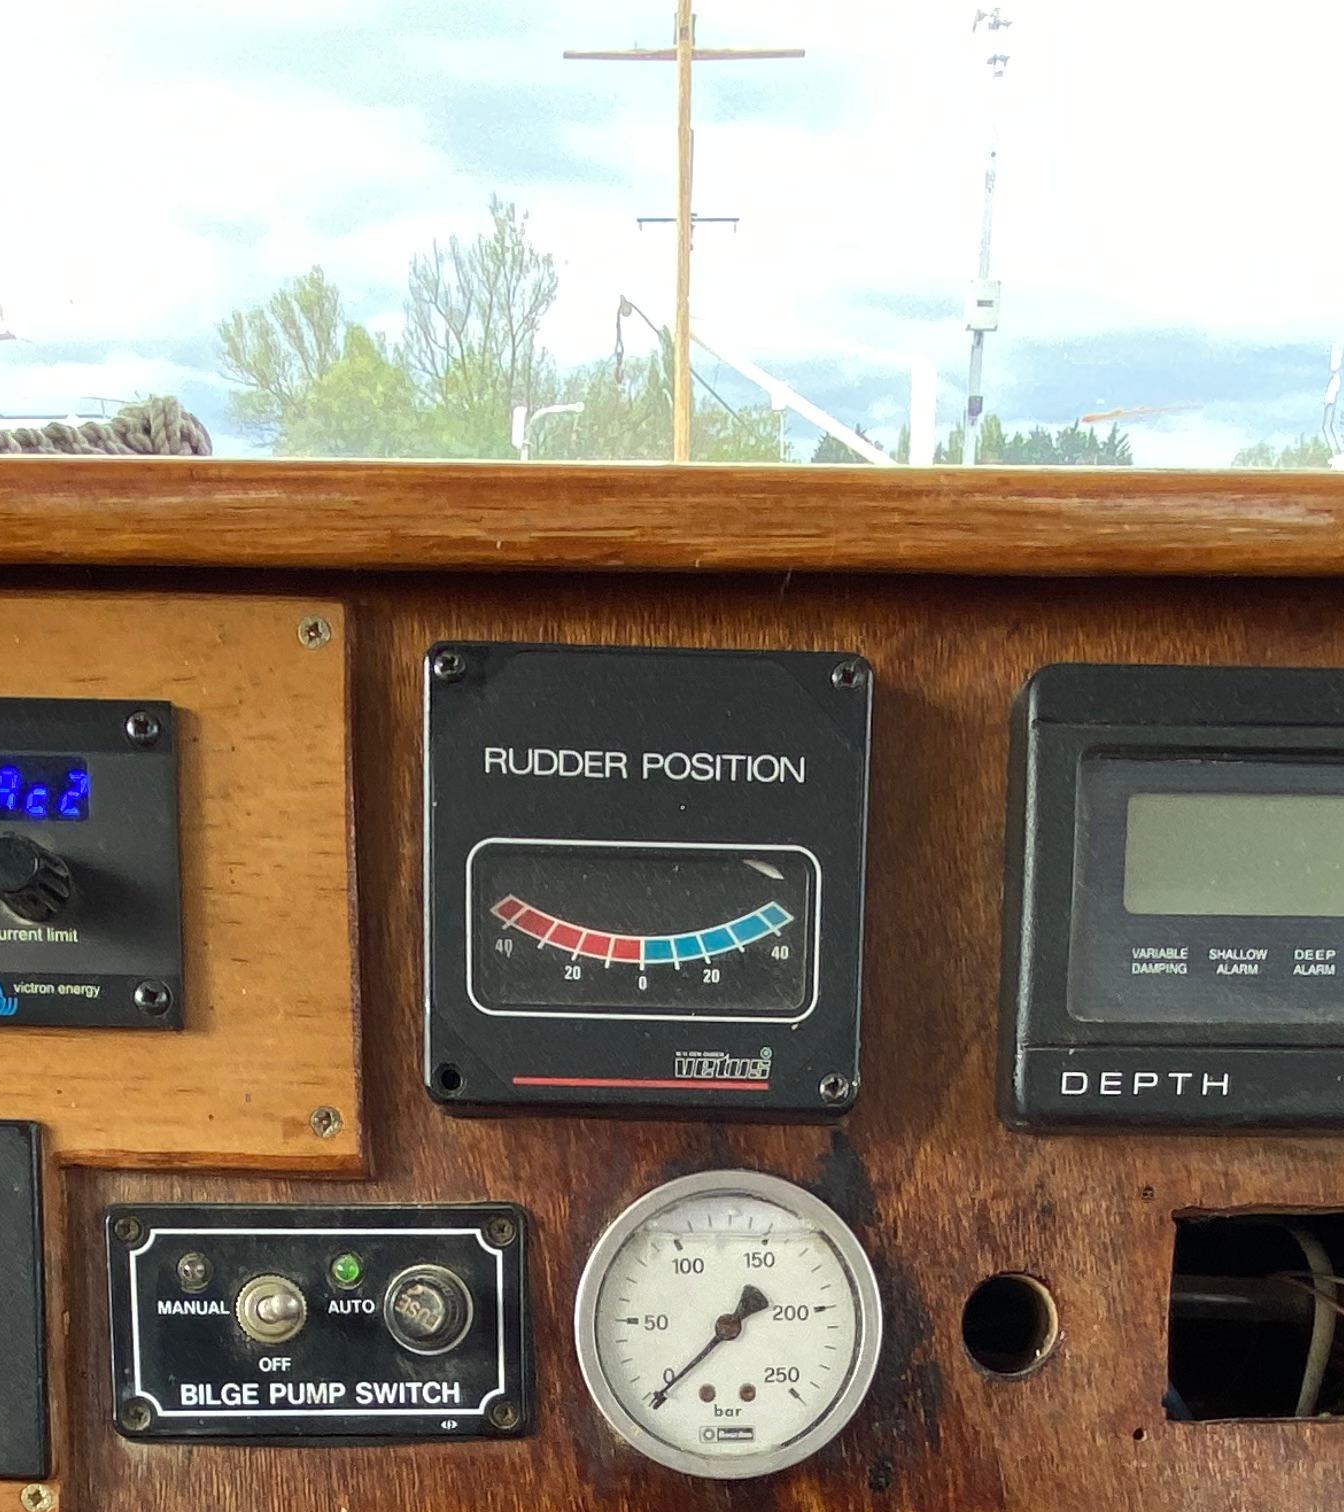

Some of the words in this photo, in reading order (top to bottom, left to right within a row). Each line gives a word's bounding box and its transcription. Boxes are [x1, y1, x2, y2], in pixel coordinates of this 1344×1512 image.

[484, 746, 628, 779] RUDDER
[641, 751, 806, 784] POSITION
[47, 927, 78, 943] limit
[771, 944, 789, 960] 40
[1132, 947, 1188, 960] VARIABLE
[1209, 948, 1268, 961] SHALLOW
[1294, 949, 1336, 961] DEEP
[564, 965, 581, 981] 20
[703, 968, 720, 984] 20
[1131, 962, 1187, 975] DAMPING
[1216, 963, 1259, 976] ALARM
[1293, 964, 1336, 976] ALARM
[13, 982, 54, 994] victron
[58, 984, 101, 998] energy
[638, 975, 647, 991] 0
[1060, 1071, 1231, 1097] DEPTH
[672, 1257, 705, 1274] 100
[744, 1251, 776, 1268] 150
[158, 1300, 231, 1315] MANUAL
[328, 1299, 375, 1314] AUTO
[772, 1304, 809, 1321] 200
[643, 1315, 669, 1331] 50
[259, 1356, 292, 1372] OFF
[662, 1368, 675, 1384] 0
[764, 1367, 800, 1383] 250
[180, 1383, 259, 1406] BILGE
[269, 1382, 346, 1405] PUMP
[355, 1381, 461, 1404] SWITCH
[714, 1403, 743, 1417] bar
